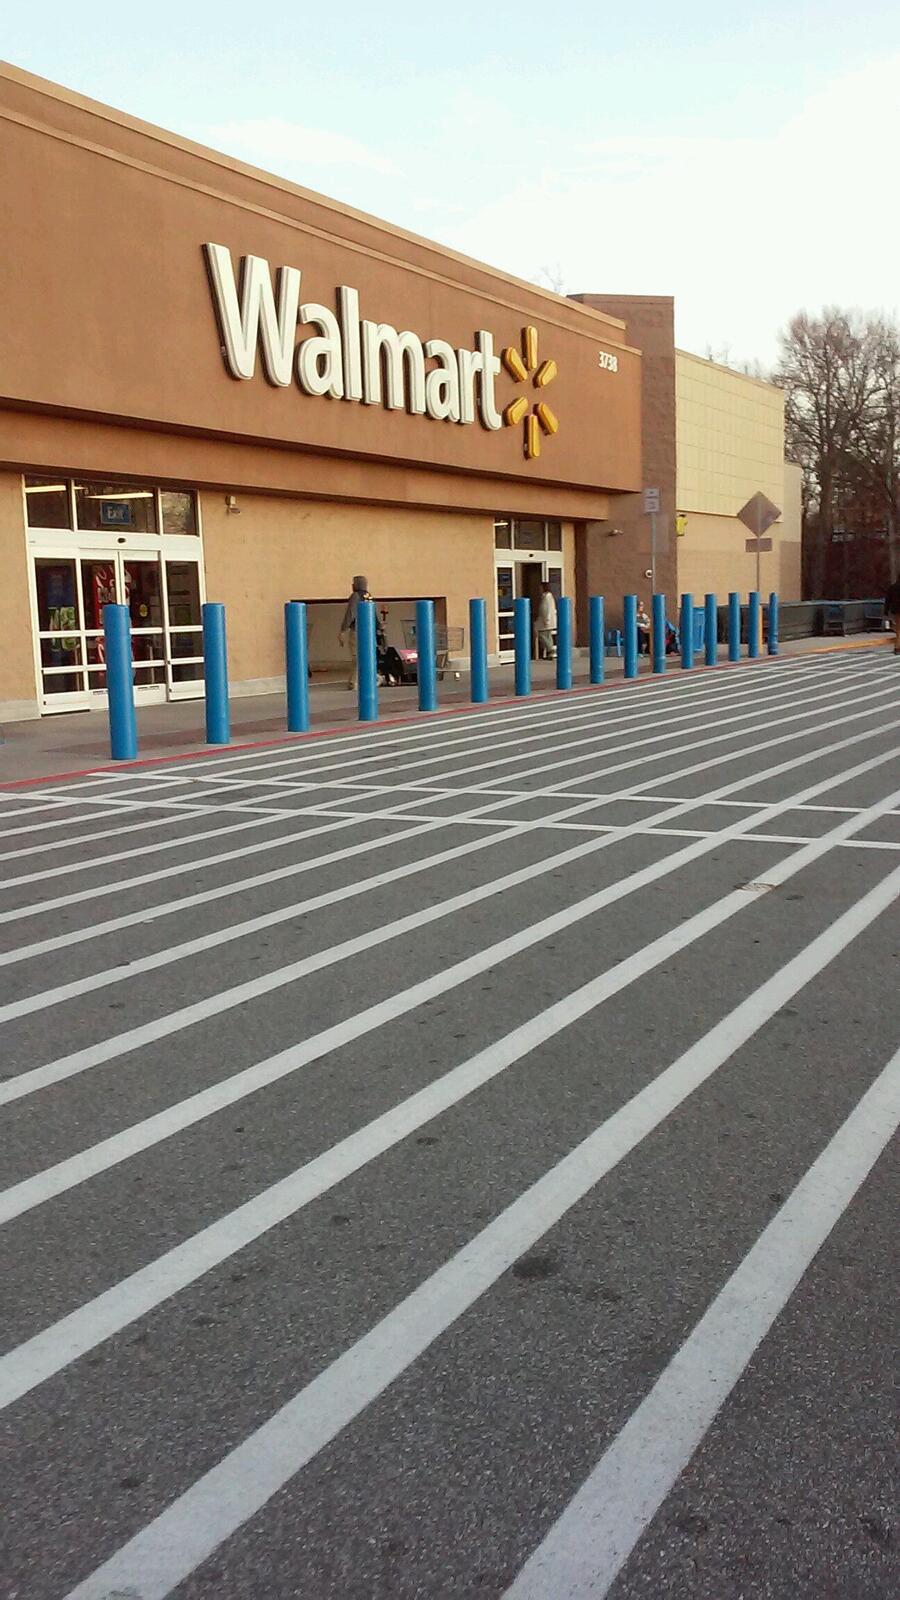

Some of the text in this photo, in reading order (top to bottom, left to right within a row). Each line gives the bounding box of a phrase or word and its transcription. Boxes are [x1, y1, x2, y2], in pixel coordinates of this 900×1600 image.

[202, 241, 501, 431] Walmart
[598, 350, 618, 373] 3738
[107, 505, 124, 520] Exit
